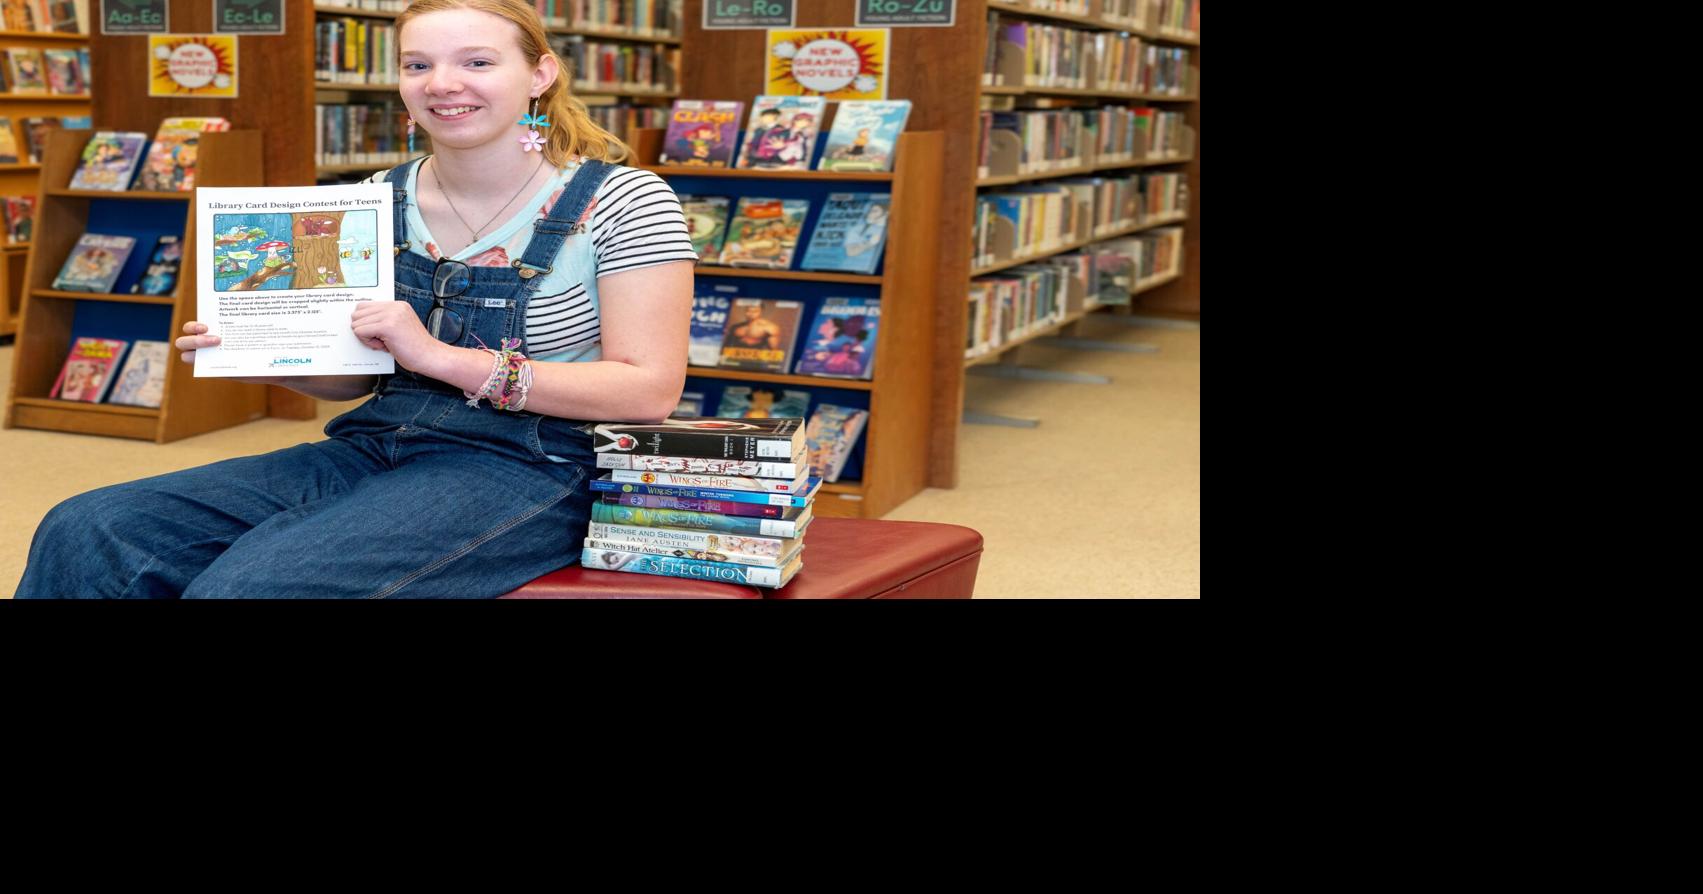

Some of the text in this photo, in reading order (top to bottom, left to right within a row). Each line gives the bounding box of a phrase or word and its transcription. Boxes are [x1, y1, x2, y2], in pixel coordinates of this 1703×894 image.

[716, 0, 783, 16] Le-Ro
[868, 0, 943, 13] Ro-Zu
[108, 10, 161, 23] Aa-Ec
[224, 9, 274, 23] Ec-Le
[795, 58, 858, 66] GRAPHIC
[796, 69, 854, 77] NOVELS
[646, 433, 662, 454] twilight
[670, 474, 701, 484] WINGS
[709, 476, 733, 487] FIRE
[646, 486, 672, 495] WINGS
[679, 488, 697, 497] FIRE
[658, 497, 690, 509] WINGS
[698, 501, 721, 511] FIRE
[642, 509, 678, 522] WINGS
[686, 514, 712, 525] FIRE
[611, 527, 636, 535] SENSE
[657, 531, 705, 541] SENSIBILITY
[603, 542, 626, 550] Witch
[642, 546, 668, 555] Atelier
[652, 538, 689, 547] AUSTEN
[649, 560, 749, 581] SELECTION
